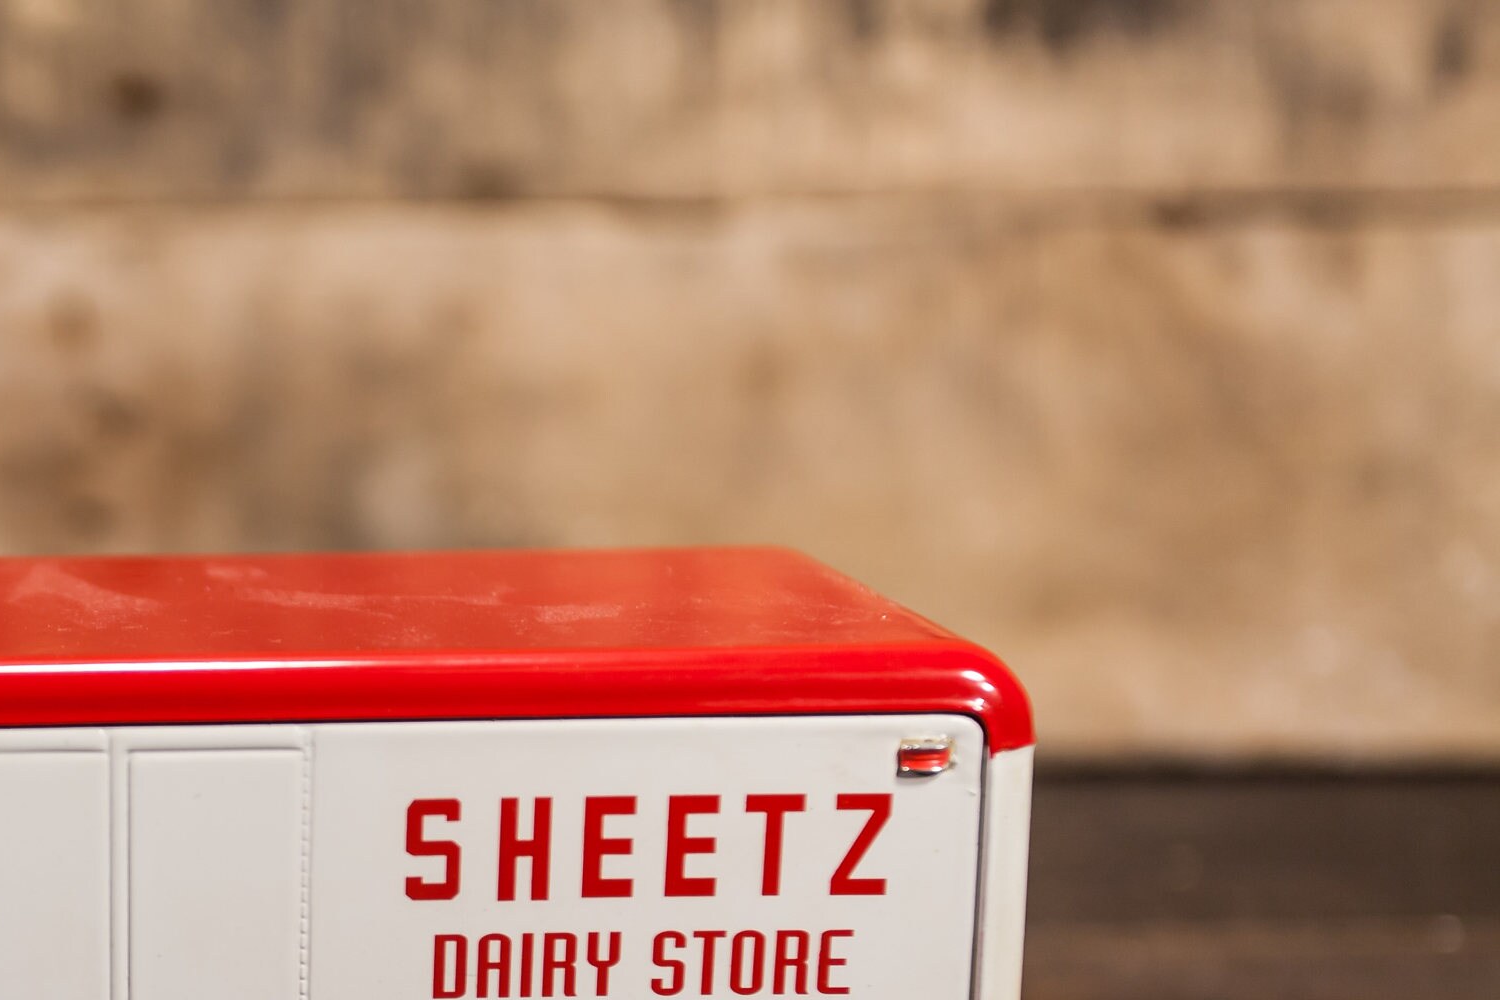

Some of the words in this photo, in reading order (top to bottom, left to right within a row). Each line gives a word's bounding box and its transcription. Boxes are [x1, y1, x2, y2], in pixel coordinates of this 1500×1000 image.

[404, 794, 893, 902] SHEETZ
[433, 931, 622, 1000] DAIRY
[650, 930, 854, 997] STORE
